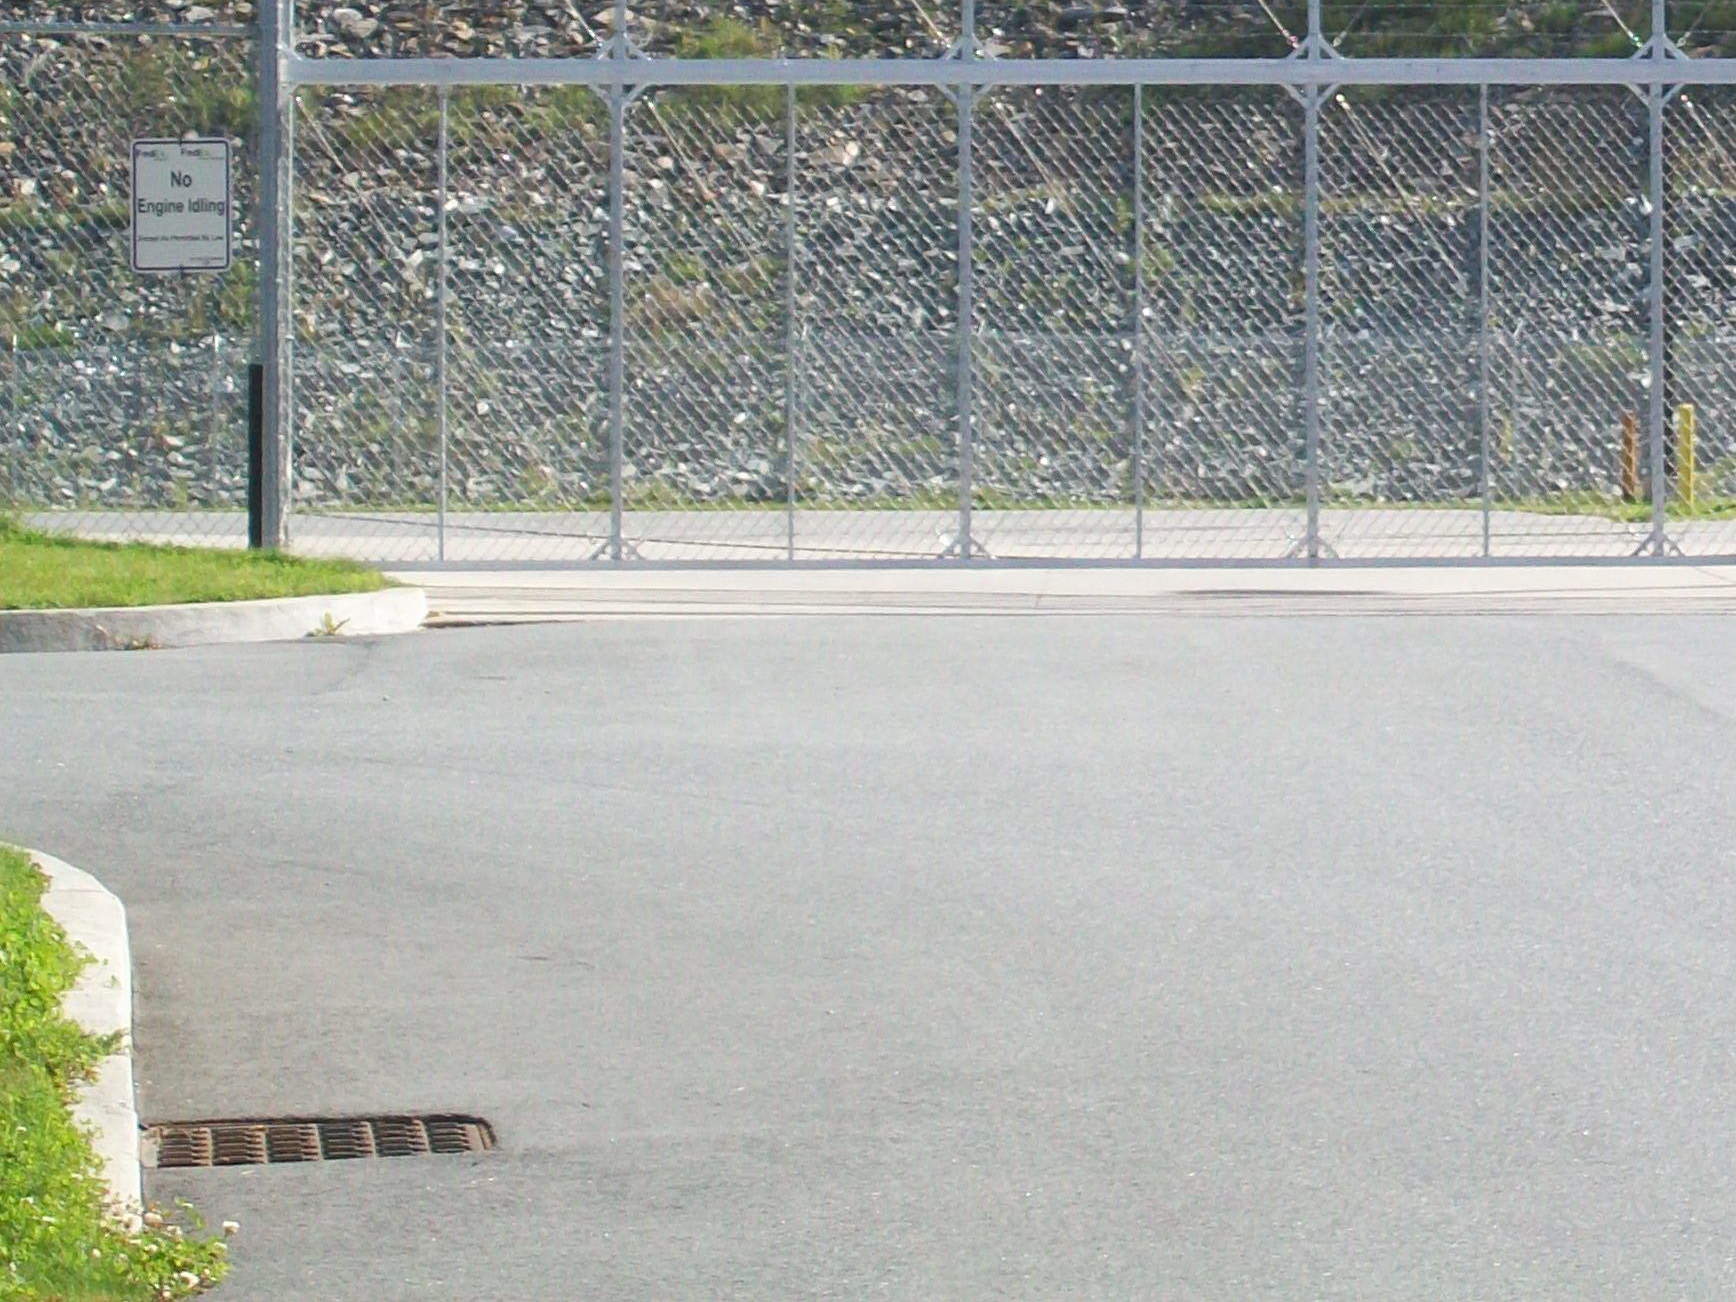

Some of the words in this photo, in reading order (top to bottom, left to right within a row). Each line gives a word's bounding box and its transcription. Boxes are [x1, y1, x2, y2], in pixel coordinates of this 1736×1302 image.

[170, 171, 192, 188] No
[138, 199, 184, 216] Engine
[188, 199, 226, 216] Idling
